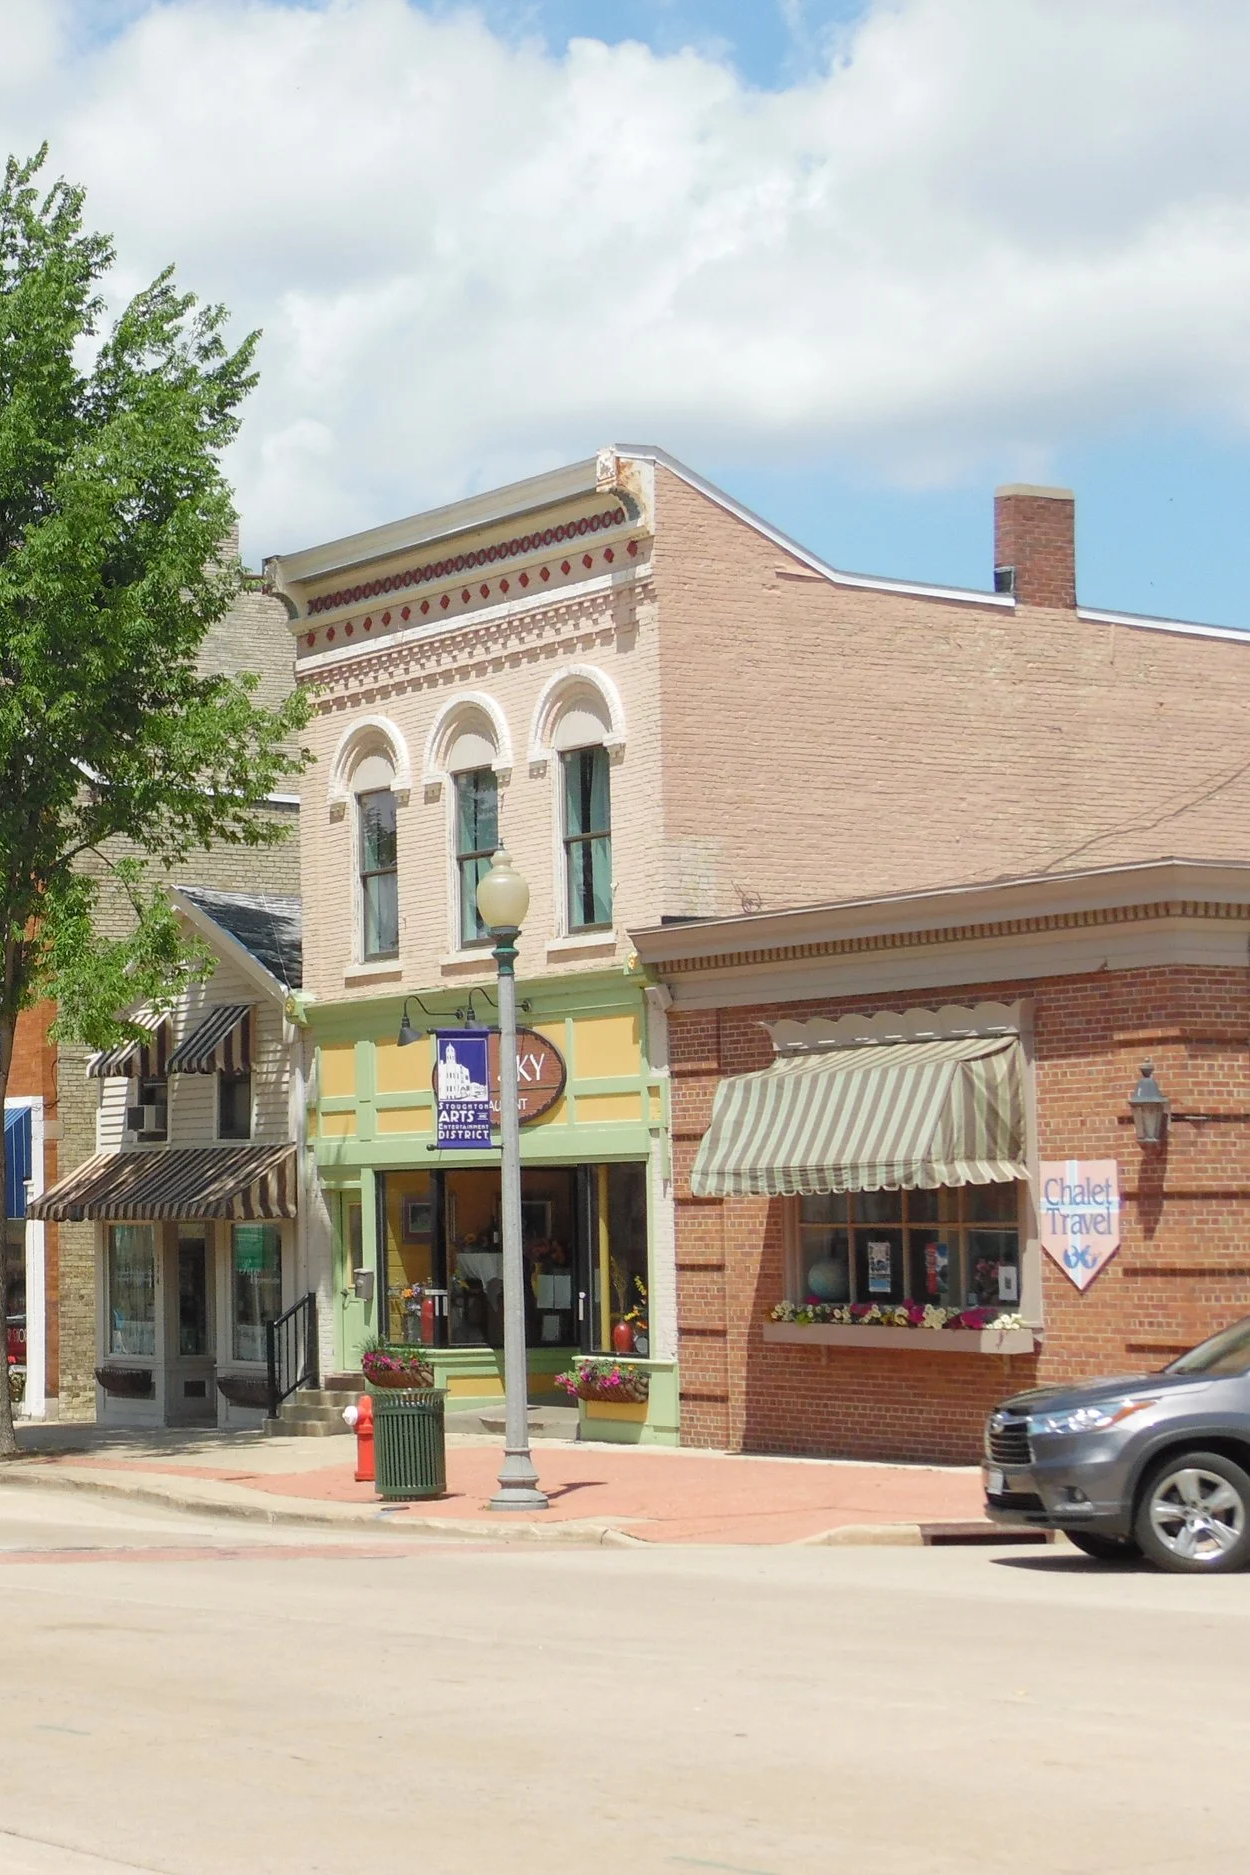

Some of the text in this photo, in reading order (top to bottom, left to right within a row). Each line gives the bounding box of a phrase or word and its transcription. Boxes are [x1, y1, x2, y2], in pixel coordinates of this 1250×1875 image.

[497, 1053, 545, 1081] KY
[438, 1102, 489, 1110] STOUGHTON
[438, 1110, 475, 1123] ARTS
[438, 1130, 489, 1140] DISTRICT
[1045, 1177, 1112, 1206] Chalet
[1046, 1206, 1113, 1235] Travel
